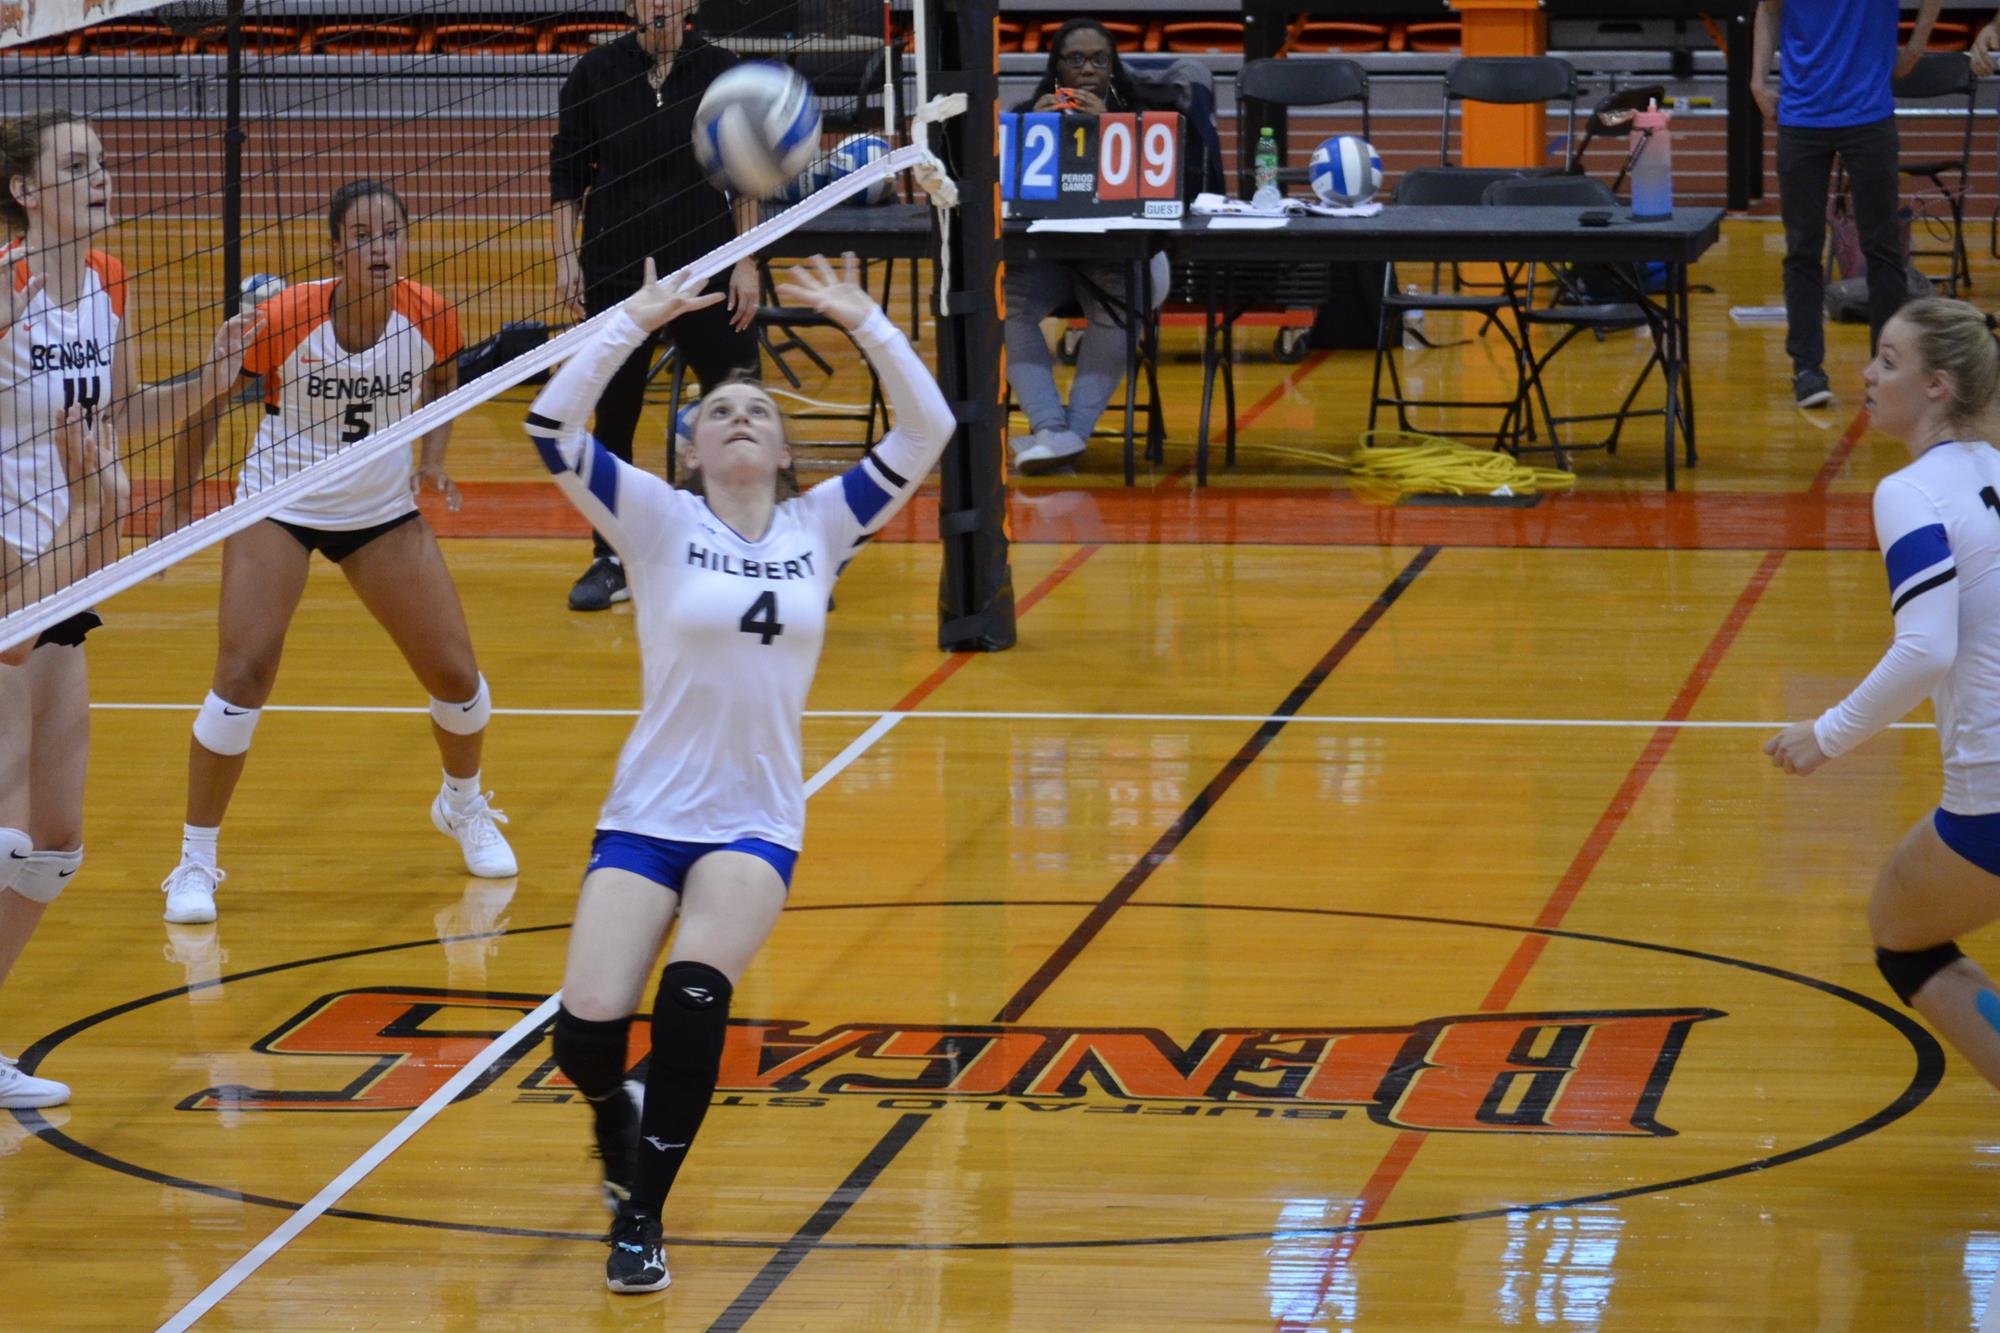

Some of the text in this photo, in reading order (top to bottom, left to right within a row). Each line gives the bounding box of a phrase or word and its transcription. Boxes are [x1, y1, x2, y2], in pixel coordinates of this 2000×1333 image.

[1073, 127, 1085, 157] 1
[1101, 122, 1174, 187] 09
[1061, 173, 1094, 183] PERIOD
[1061, 182, 1093, 192] GAMES
[1146, 204, 1180, 215] GUEST
[31, 338, 111, 371] BENGAL
[307, 371, 413, 400] BENGALS
[341, 403, 373, 443] 5
[687, 541, 816, 580] HILBERT
[739, 590, 785, 646] 4
[175, 988, 1728, 1137] BENGAS
[512, 1092, 1347, 1119] BUFFALO STE
